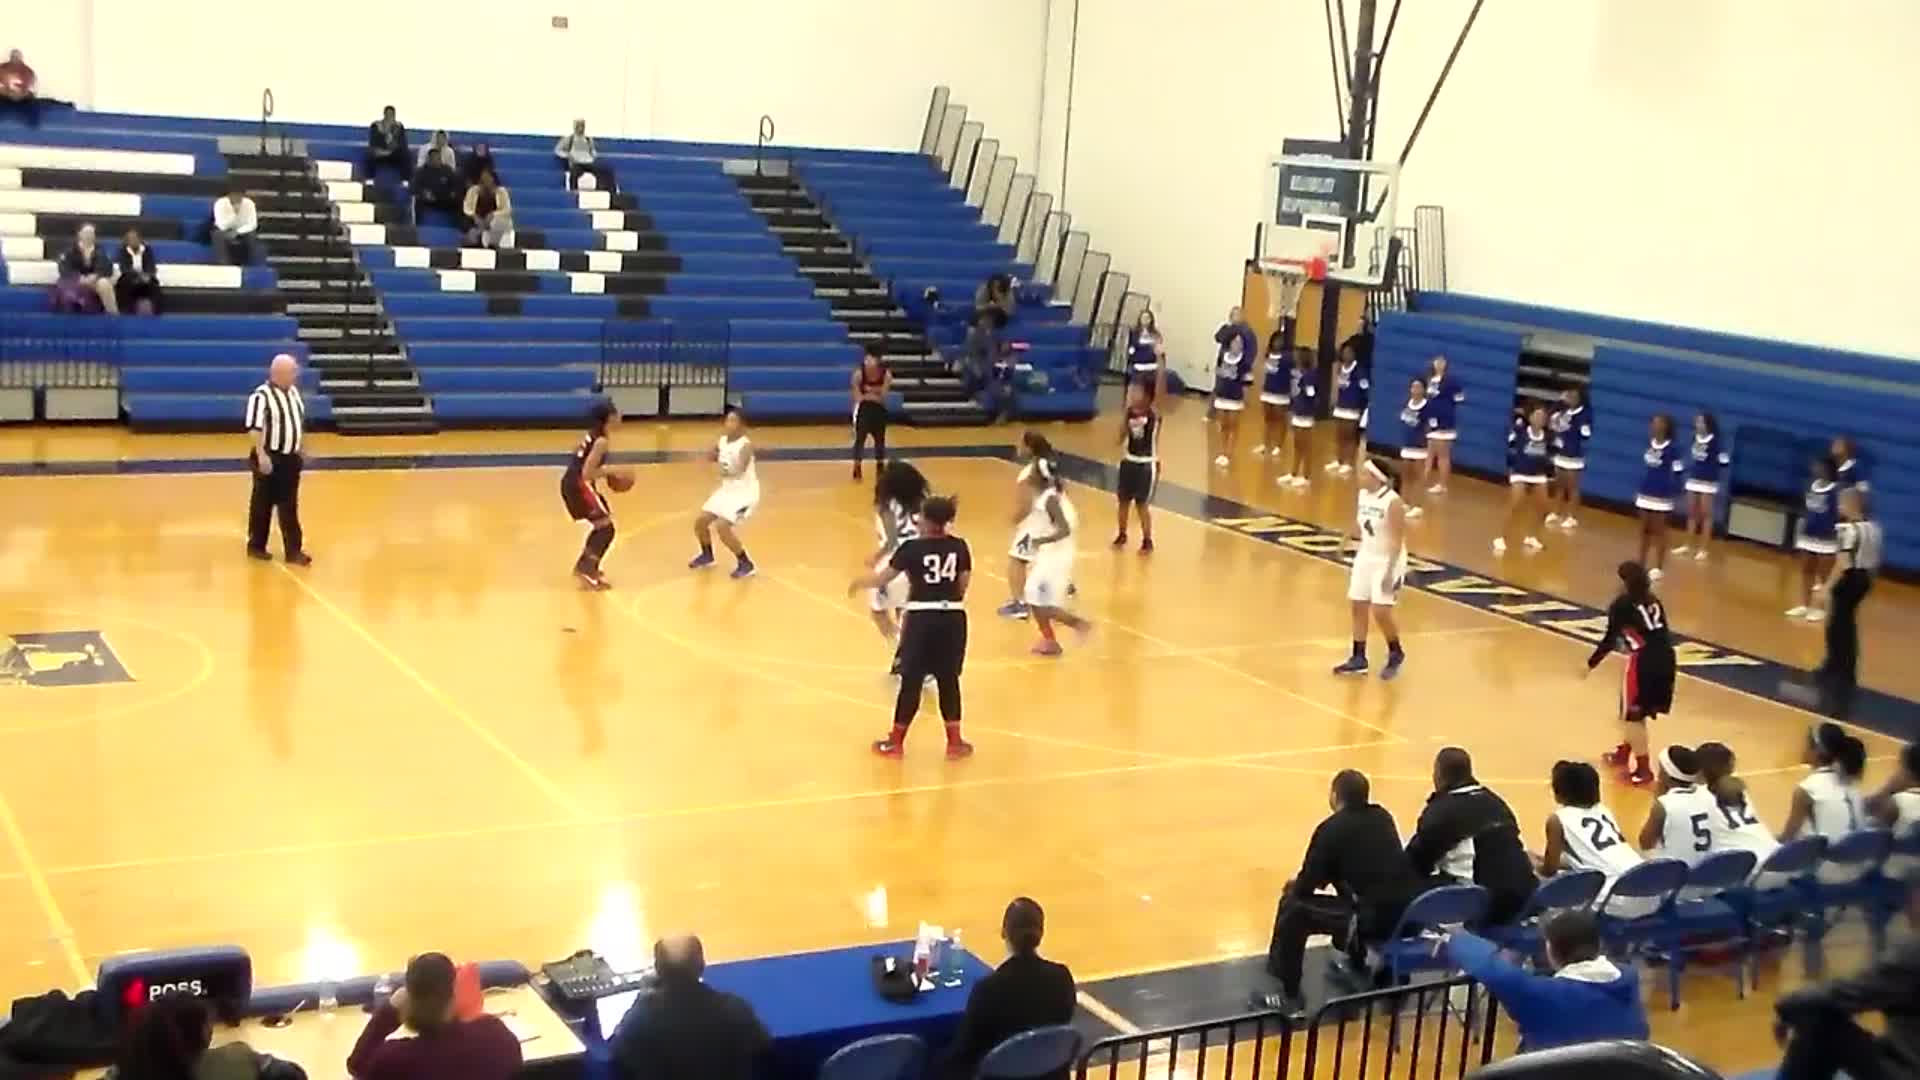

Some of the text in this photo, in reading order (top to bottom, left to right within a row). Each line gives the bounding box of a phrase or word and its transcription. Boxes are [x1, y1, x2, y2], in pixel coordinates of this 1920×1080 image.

[1363, 519, 1375, 537] 4
[923, 552, 957, 584] 34
[1636, 603, 1663, 631] 12
[1690, 812, 1712, 851] 5
